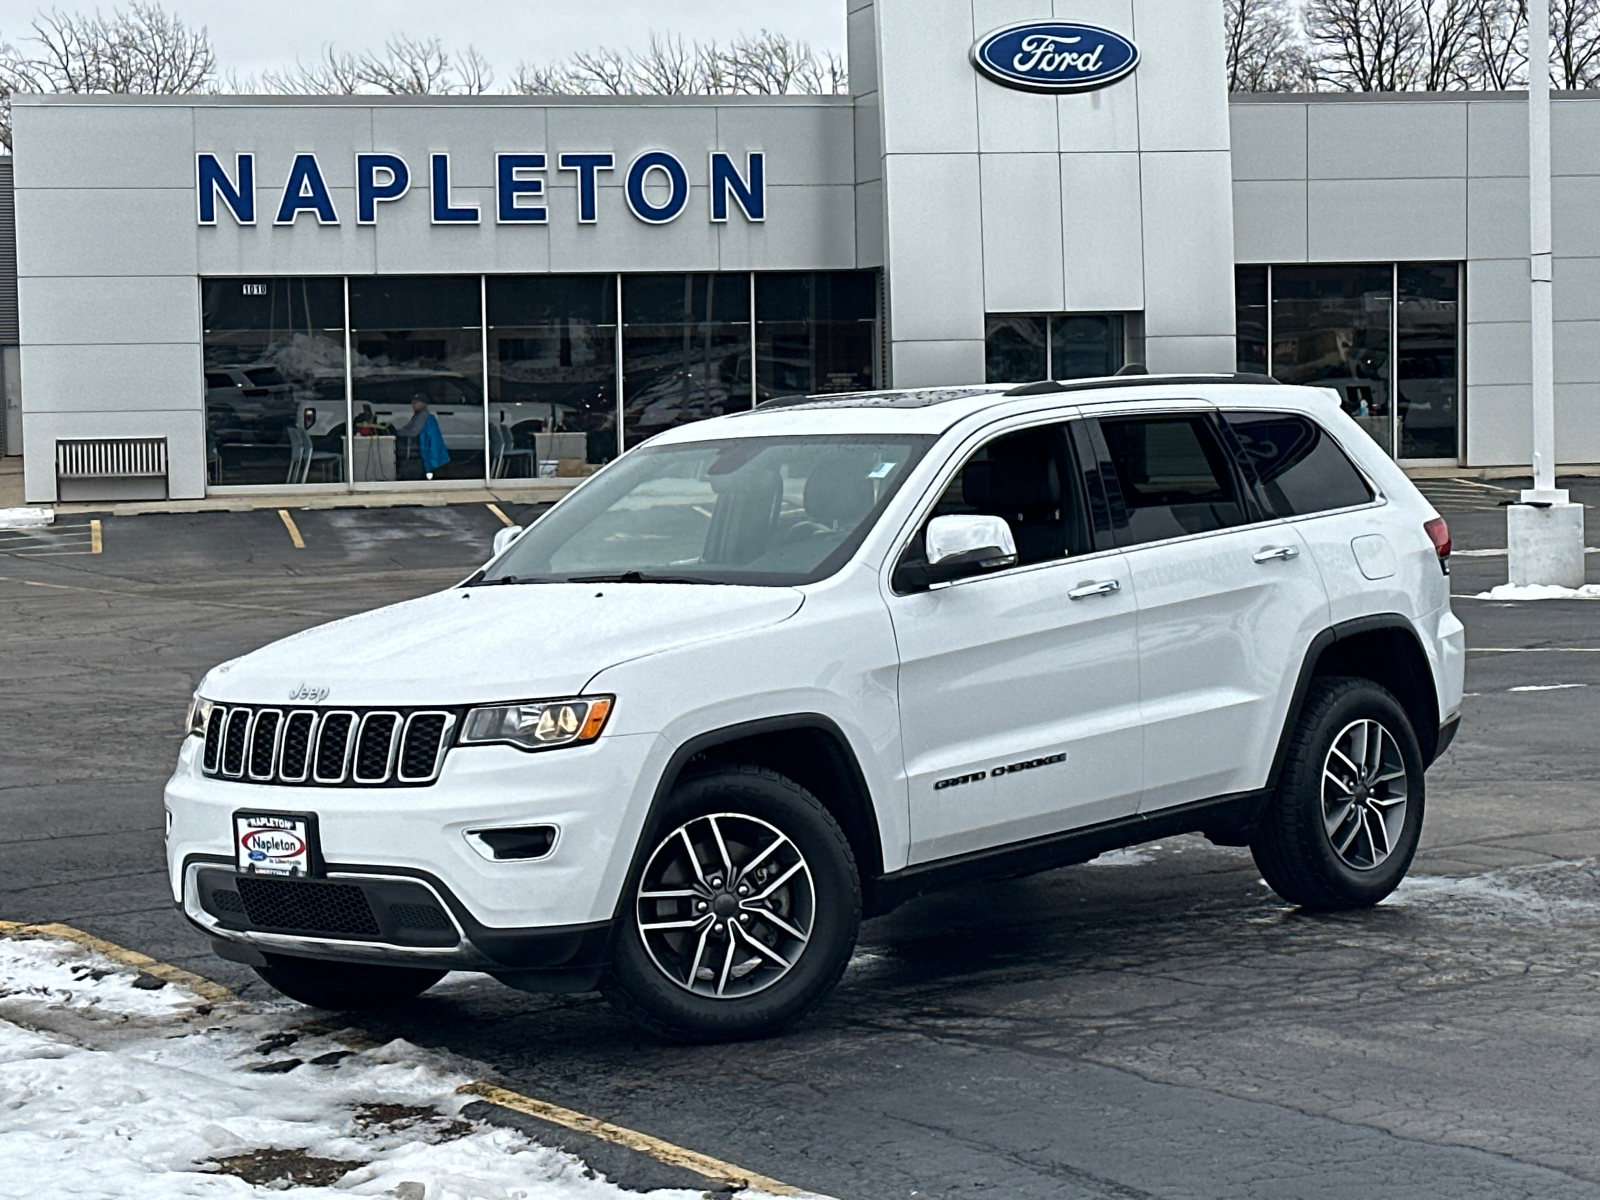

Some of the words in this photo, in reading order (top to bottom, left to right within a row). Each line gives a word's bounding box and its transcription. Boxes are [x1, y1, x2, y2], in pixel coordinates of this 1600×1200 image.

[1013, 34, 1105, 72] Ford
[195, 150, 767, 225] NAPLETON
[242, 284, 267, 295] 1010
[289, 682, 330, 704] Jeep
[933, 771, 987, 790] GRAND
[991, 752, 1067, 777] CHEROKEE
[250, 817, 292, 829] NAPLETON
[252, 835, 296, 853] Napleton
